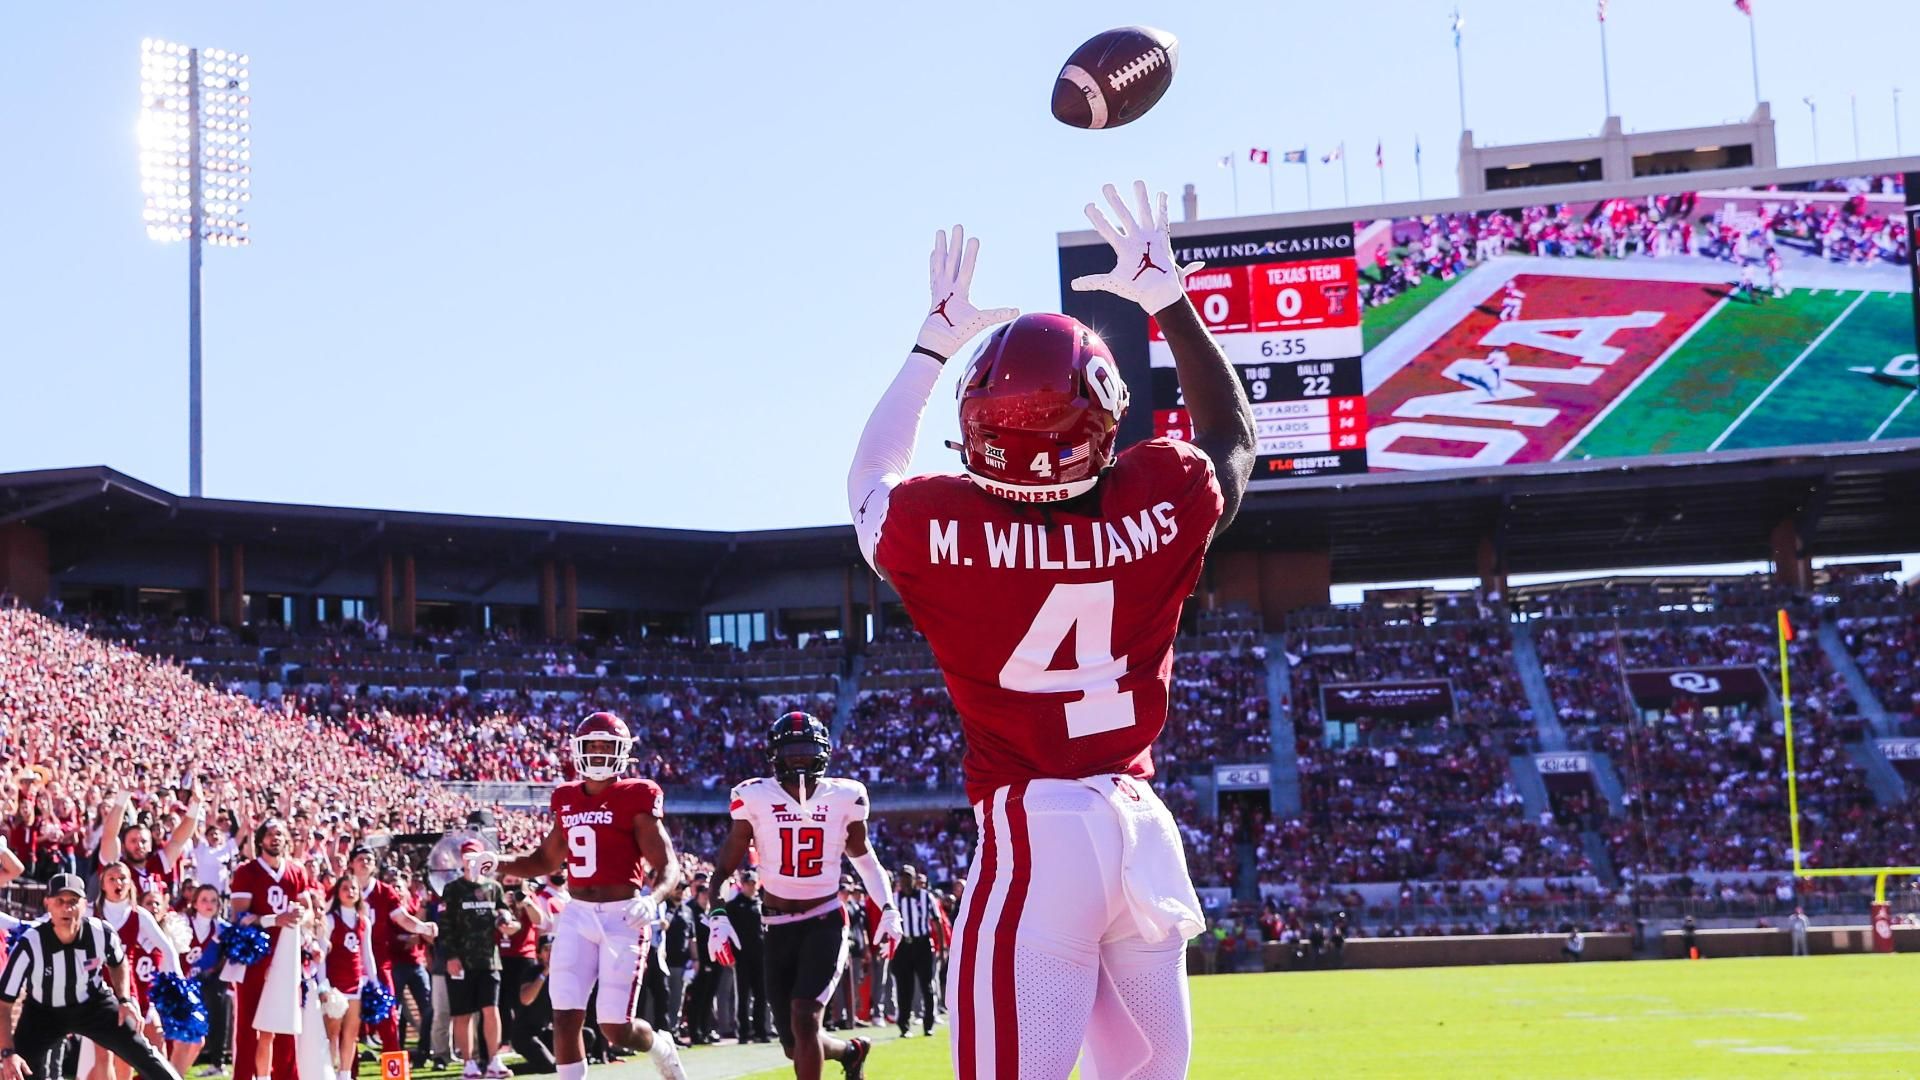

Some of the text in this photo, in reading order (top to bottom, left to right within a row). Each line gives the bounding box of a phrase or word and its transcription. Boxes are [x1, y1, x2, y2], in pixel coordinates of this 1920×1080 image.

[1276, 235, 1350, 253] CASINO
[1267, 264, 1341, 285] TEXAS TECH
[1204, 293, 1229, 323] 0
[1277, 288, 1302, 317] 0
[1261, 338, 1306, 357] 6:35
[1297, 364, 1318, 376] BALL
[1251, 381, 1268, 400] 9
[1303, 376, 1331, 396] 22
[985, 456, 1006, 470] UNITY
[1030, 452, 1052, 477] 4
[985, 484, 1069, 502] SOONERS
[929, 502, 1178, 569] M. WILLIAMS
[999, 580, 1136, 739] 4
[561, 811, 613, 828] SOONERS
[568, 825, 597, 878] 9
[779, 827, 824, 878] 12
[44, 966, 53, 977] S
[388, 1059, 400, 1076] OU
